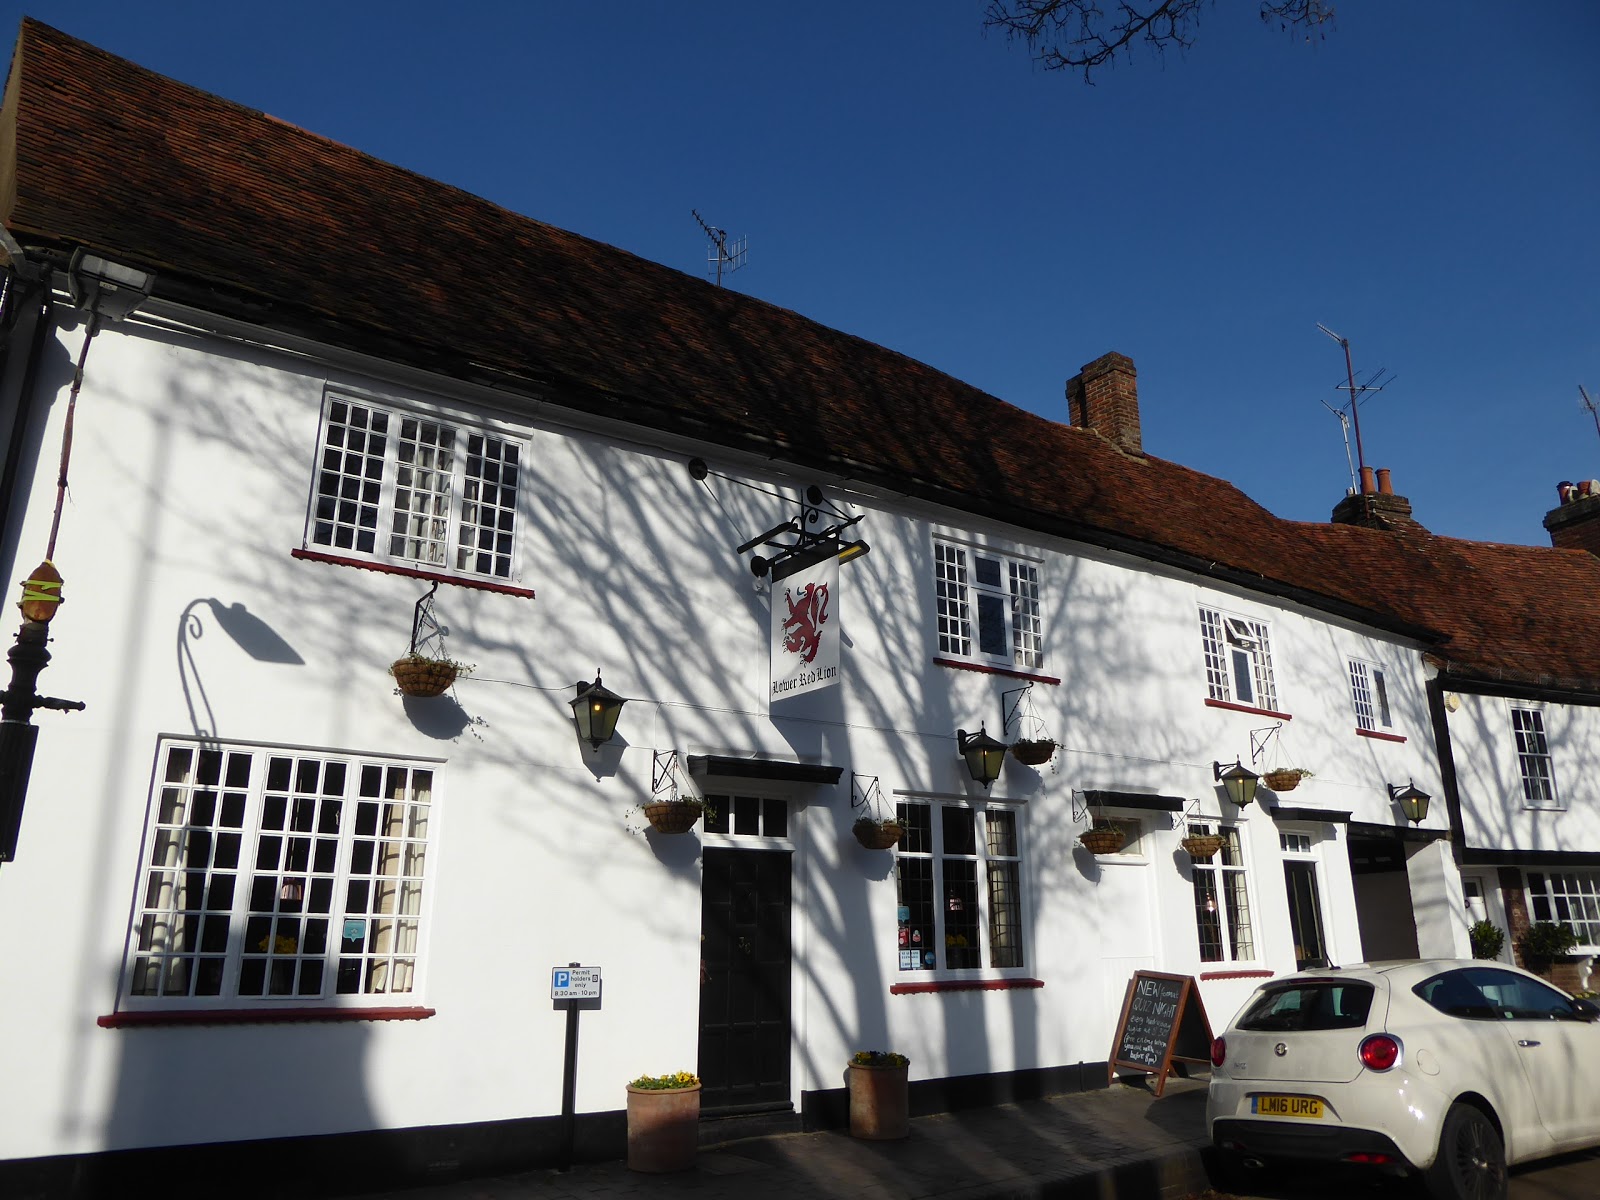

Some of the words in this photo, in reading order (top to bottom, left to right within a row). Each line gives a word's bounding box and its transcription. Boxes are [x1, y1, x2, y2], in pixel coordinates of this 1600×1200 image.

[772, 678, 797, 696] Lower
[799, 671, 816, 687] Red
[816, 665, 837, 682] Lion
[1136, 980, 1162, 998] NEW
[1132, 997, 1152, 1013] QUIZ
[1151, 1001, 1177, 1019] NIGHT
[1261, 1097, 1288, 1113] LM16
[1291, 1099, 1318, 1115] URG
